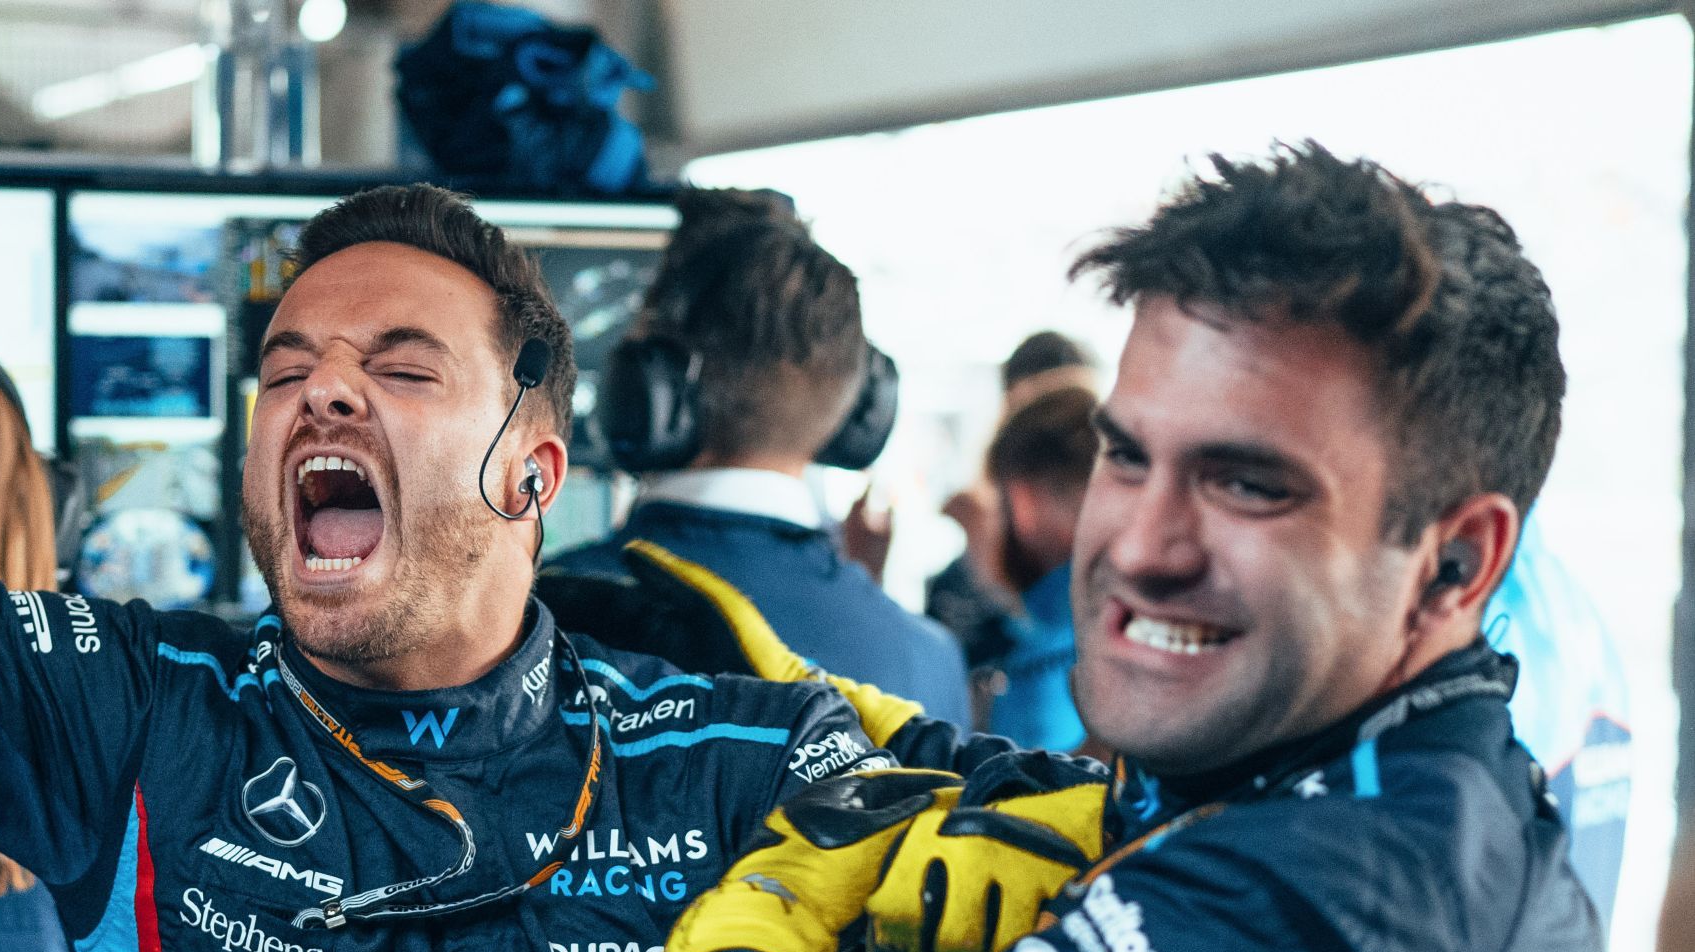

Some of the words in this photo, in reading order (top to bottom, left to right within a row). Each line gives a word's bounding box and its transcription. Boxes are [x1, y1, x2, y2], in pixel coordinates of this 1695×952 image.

[402, 707, 460, 749] W
[609, 698, 695, 732] raken
[243, 855, 344, 896] AMG
[551, 865, 687, 902] RACNG
